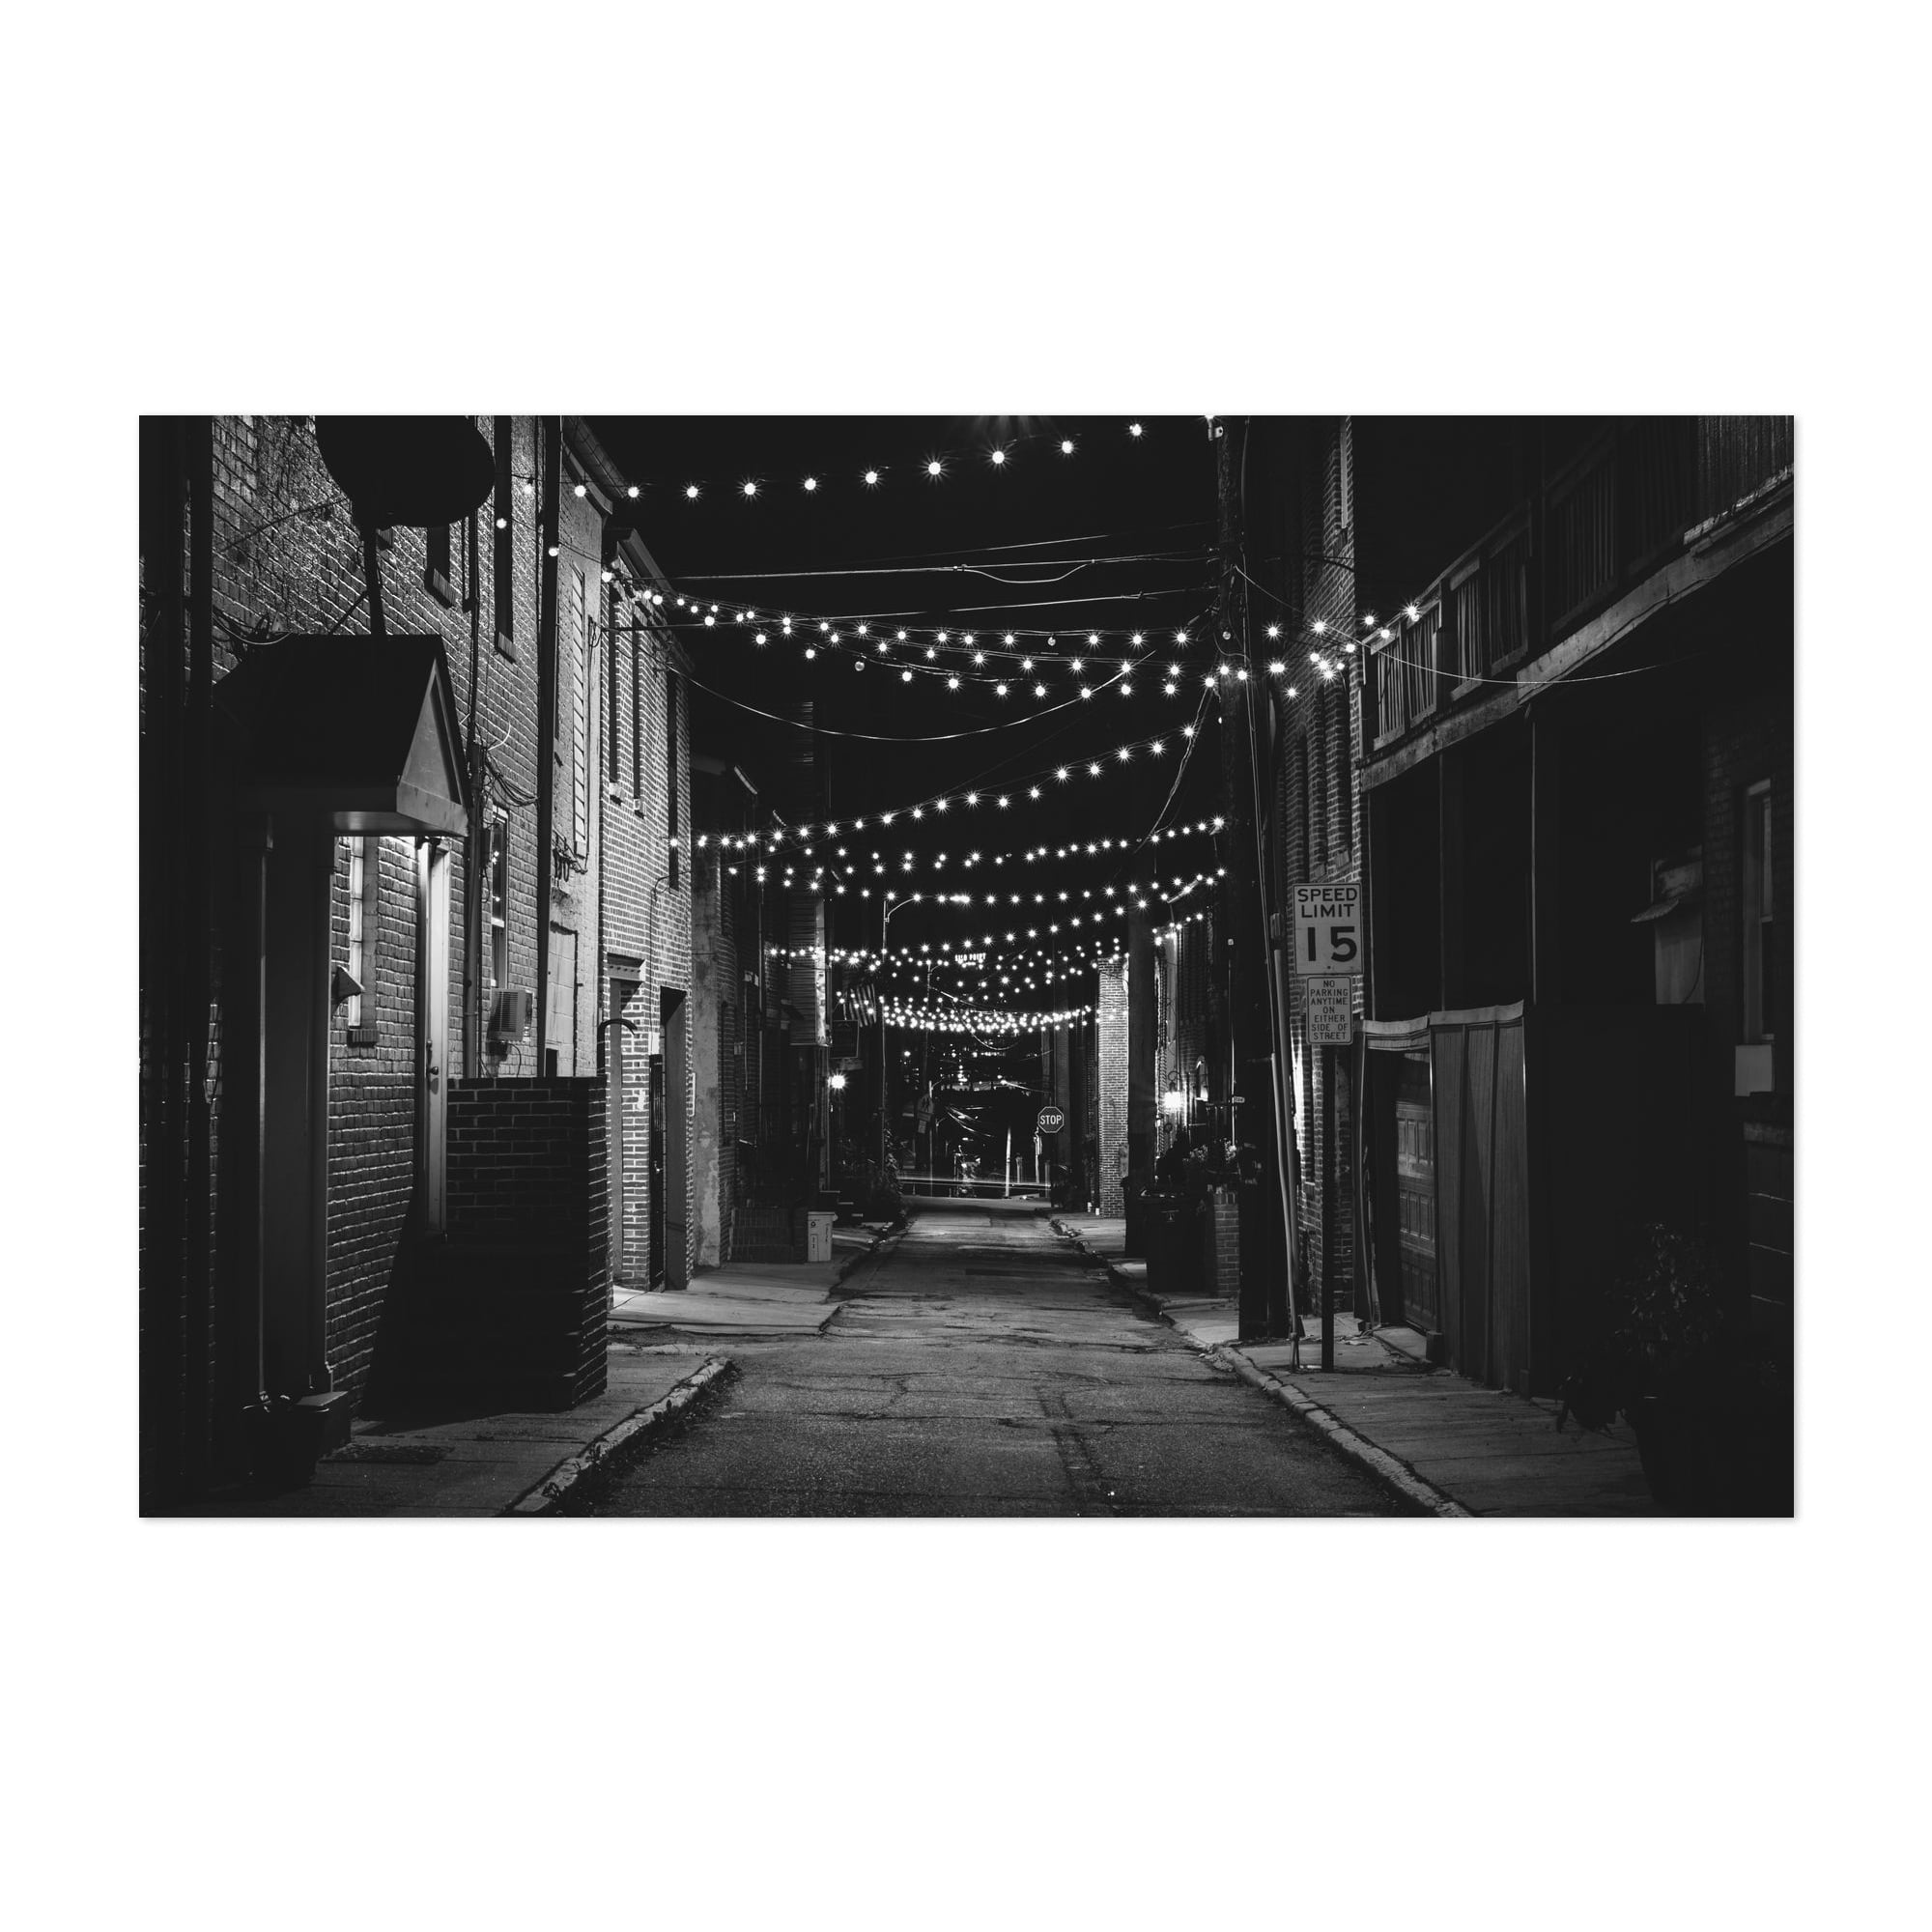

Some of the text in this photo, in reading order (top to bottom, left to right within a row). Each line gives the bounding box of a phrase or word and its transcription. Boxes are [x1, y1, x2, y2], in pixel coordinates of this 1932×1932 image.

[1297, 888, 1357, 902] SPEED
[1301, 904, 1354, 918] LIMIT
[1307, 925, 1357, 962] 15
[1322, 980, 1335, 988] NO
[1310, 988, 1349, 997] PARKING
[1310, 997, 1349, 1006] ANYTIME
[1322, 1006, 1335, 1014] ON
[1311, 1023, 1330, 1032] SIDE
[1313, 1032, 1346, 1040] STREET
[1039, 1115, 1063, 1125] STOP
